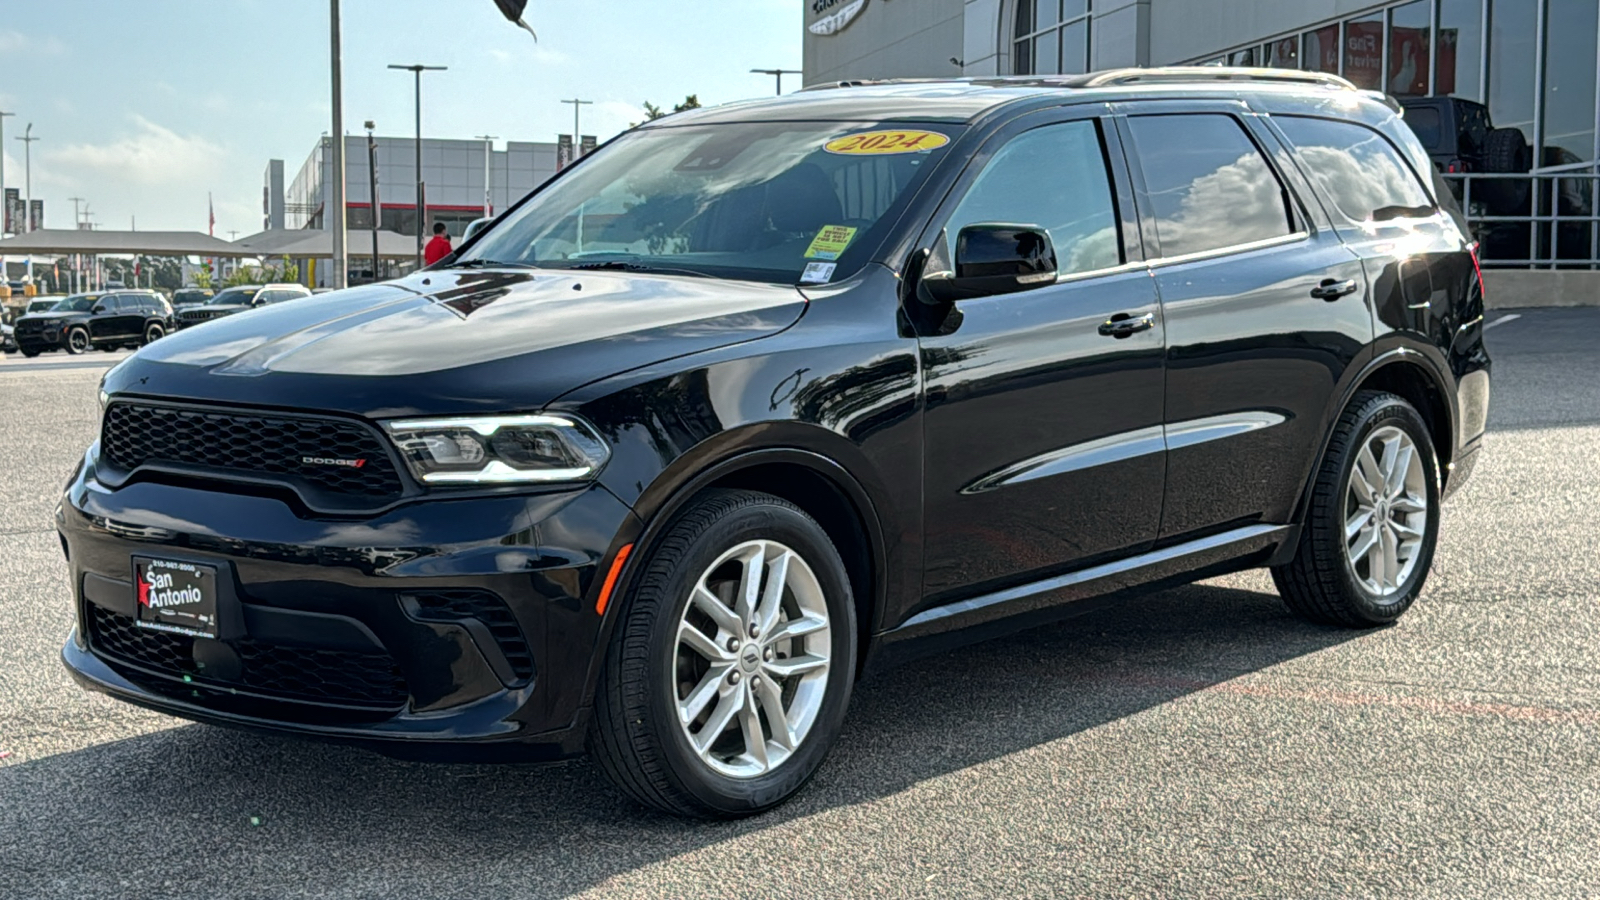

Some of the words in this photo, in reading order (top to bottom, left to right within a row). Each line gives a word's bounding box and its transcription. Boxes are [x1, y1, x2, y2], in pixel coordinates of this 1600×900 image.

[837, 133, 929, 151] 2024
[302, 456, 356, 467] DODGE
[146, 571, 173, 590] San
[149, 584, 201, 609] Antonio
